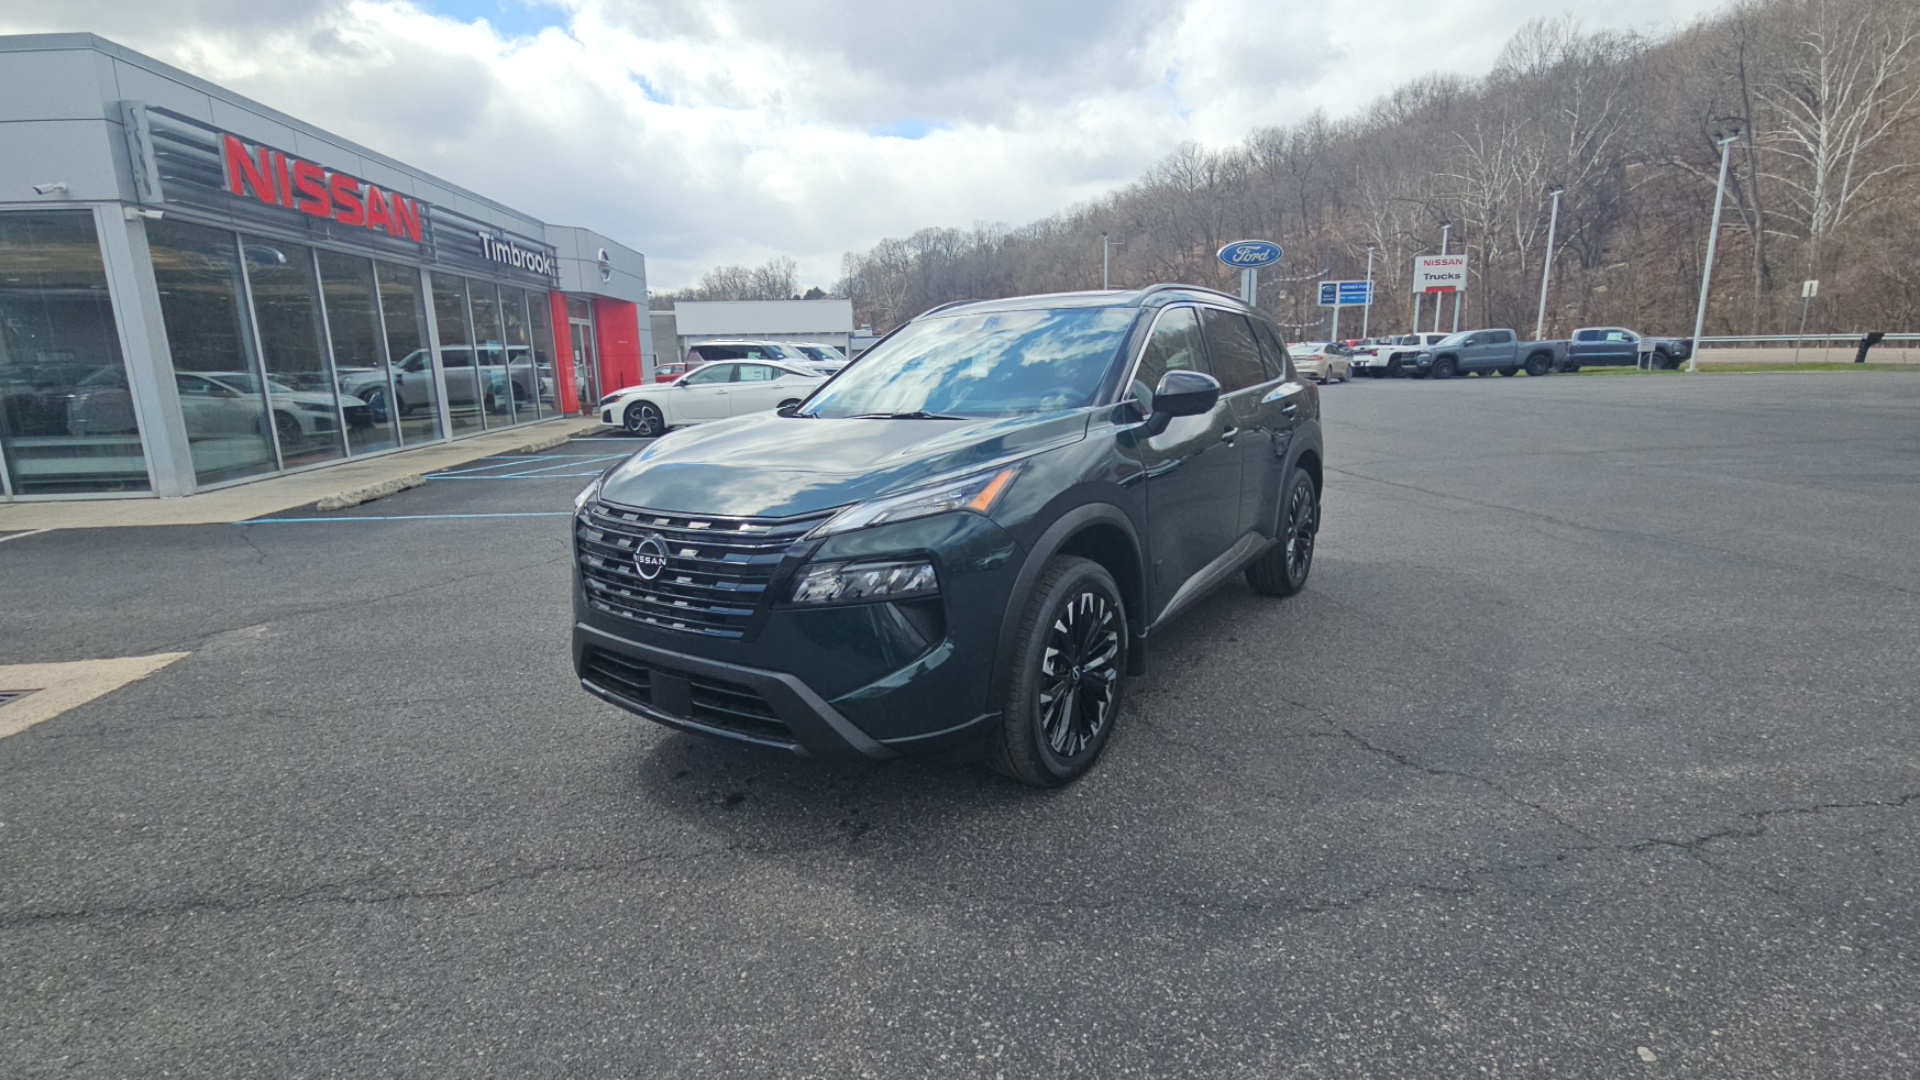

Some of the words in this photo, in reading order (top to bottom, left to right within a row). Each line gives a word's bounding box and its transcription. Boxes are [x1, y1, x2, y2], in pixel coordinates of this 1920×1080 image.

[220, 133, 422, 243] NISSAN
[478, 231, 552, 275] Timbrook
[1232, 245, 1270, 263] Ford
[633, 554, 666, 565] NISSAN
